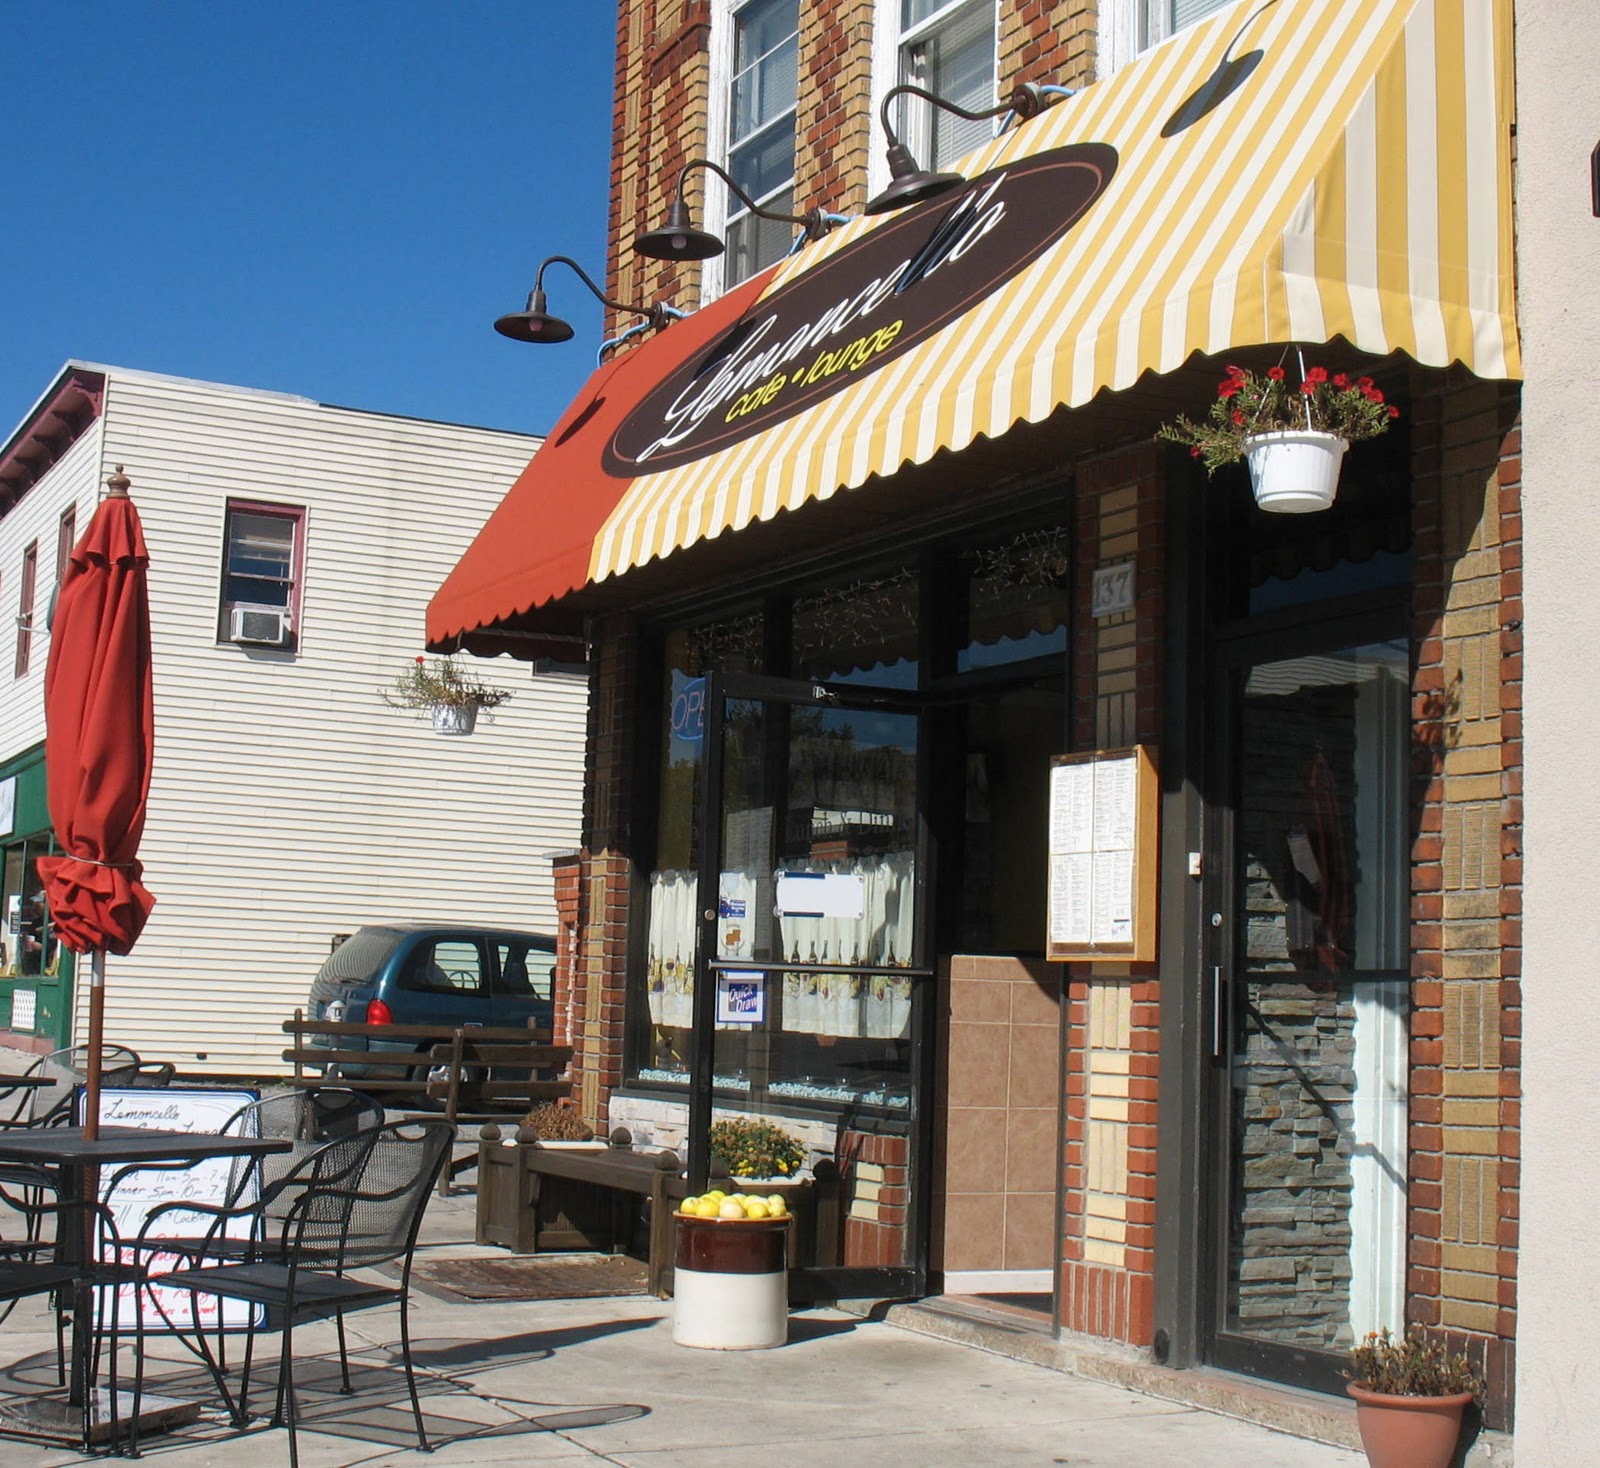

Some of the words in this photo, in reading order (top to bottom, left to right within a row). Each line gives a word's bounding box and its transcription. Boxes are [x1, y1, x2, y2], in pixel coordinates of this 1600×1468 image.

[724, 372, 788, 424] cafe
[799, 319, 904, 388] lounge
[671, 691, 705, 730] OPE
[729, 983, 754, 1003] Quick
[736, 997, 758, 1013] Draw
